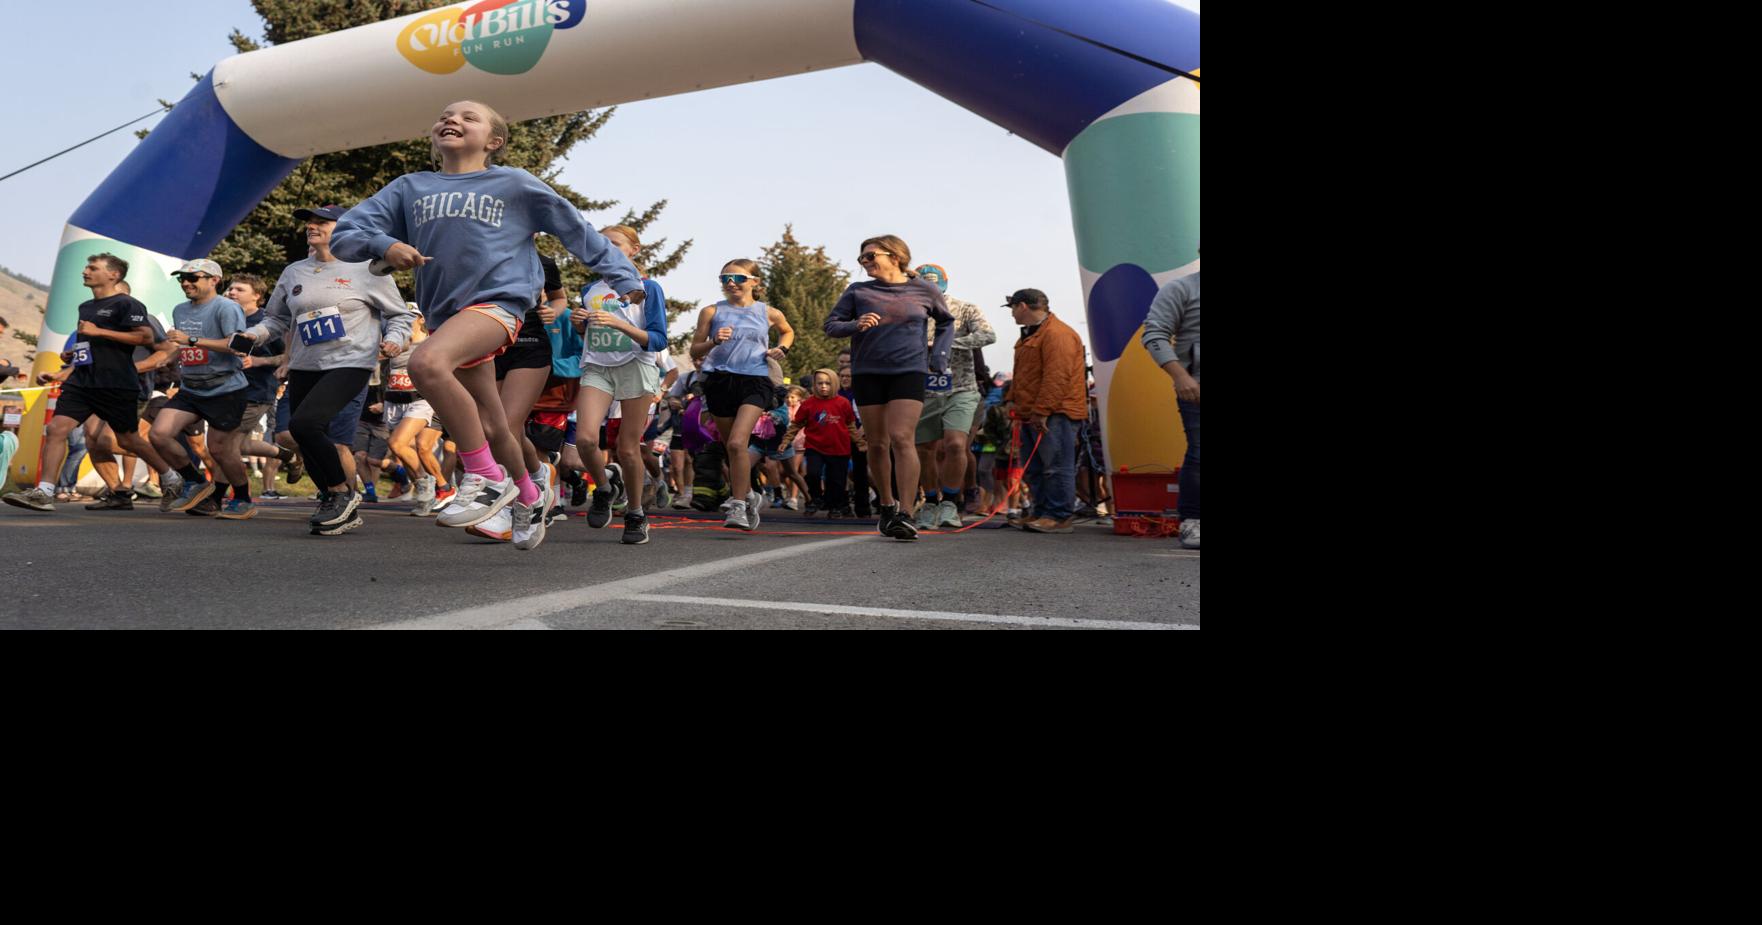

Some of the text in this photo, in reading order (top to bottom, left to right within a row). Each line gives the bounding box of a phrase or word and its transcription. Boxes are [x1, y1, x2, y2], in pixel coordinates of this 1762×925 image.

[410, 13, 474, 51] Old
[454, 35, 525, 57] FUN RUN
[413, 191, 504, 228] CHICAGO
[303, 318, 336, 339] 111
[591, 332, 624, 347] 507
[181, 349, 204, 361] 333
[391, 375, 412, 387] 349
[928, 375, 948, 386] 26
